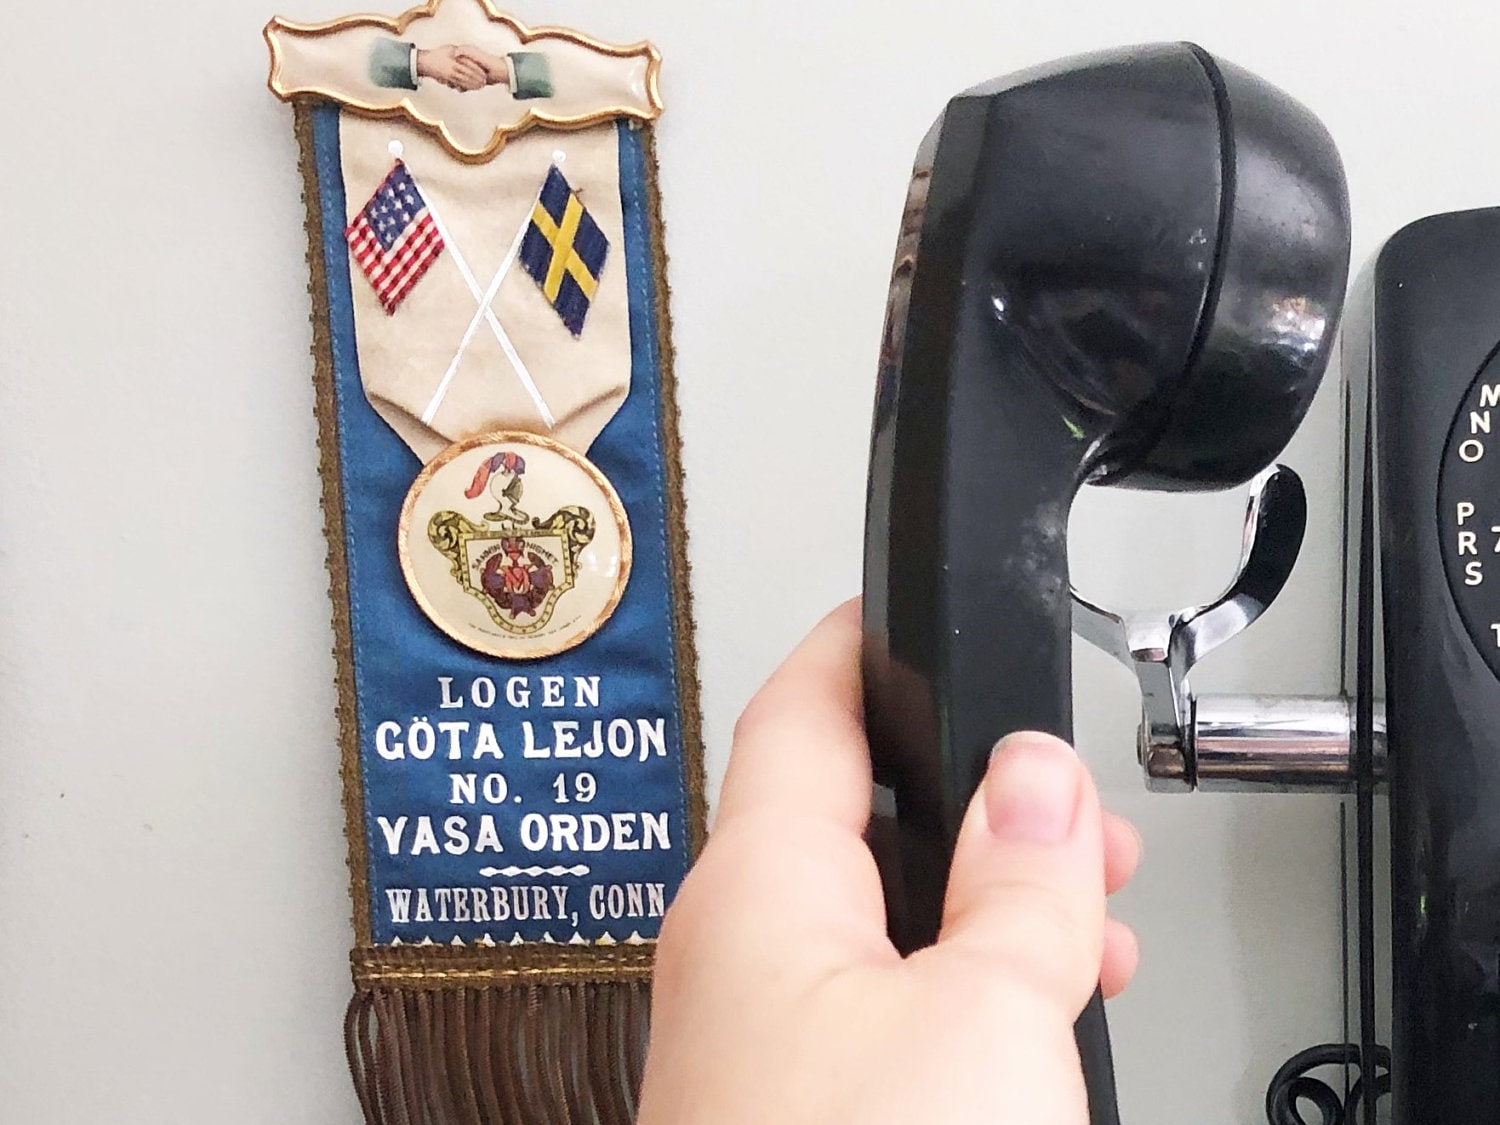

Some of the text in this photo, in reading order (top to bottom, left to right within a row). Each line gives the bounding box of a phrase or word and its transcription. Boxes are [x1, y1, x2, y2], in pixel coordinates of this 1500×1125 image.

[437, 675, 601, 709] LOGEN
[375, 716, 667, 762] GÖTA LEJON
[448, 772, 597, 805] NO. 19
[376, 812, 672, 856] VASA ORDEN
[385, 882, 665, 927] WATERBURY, CONN
